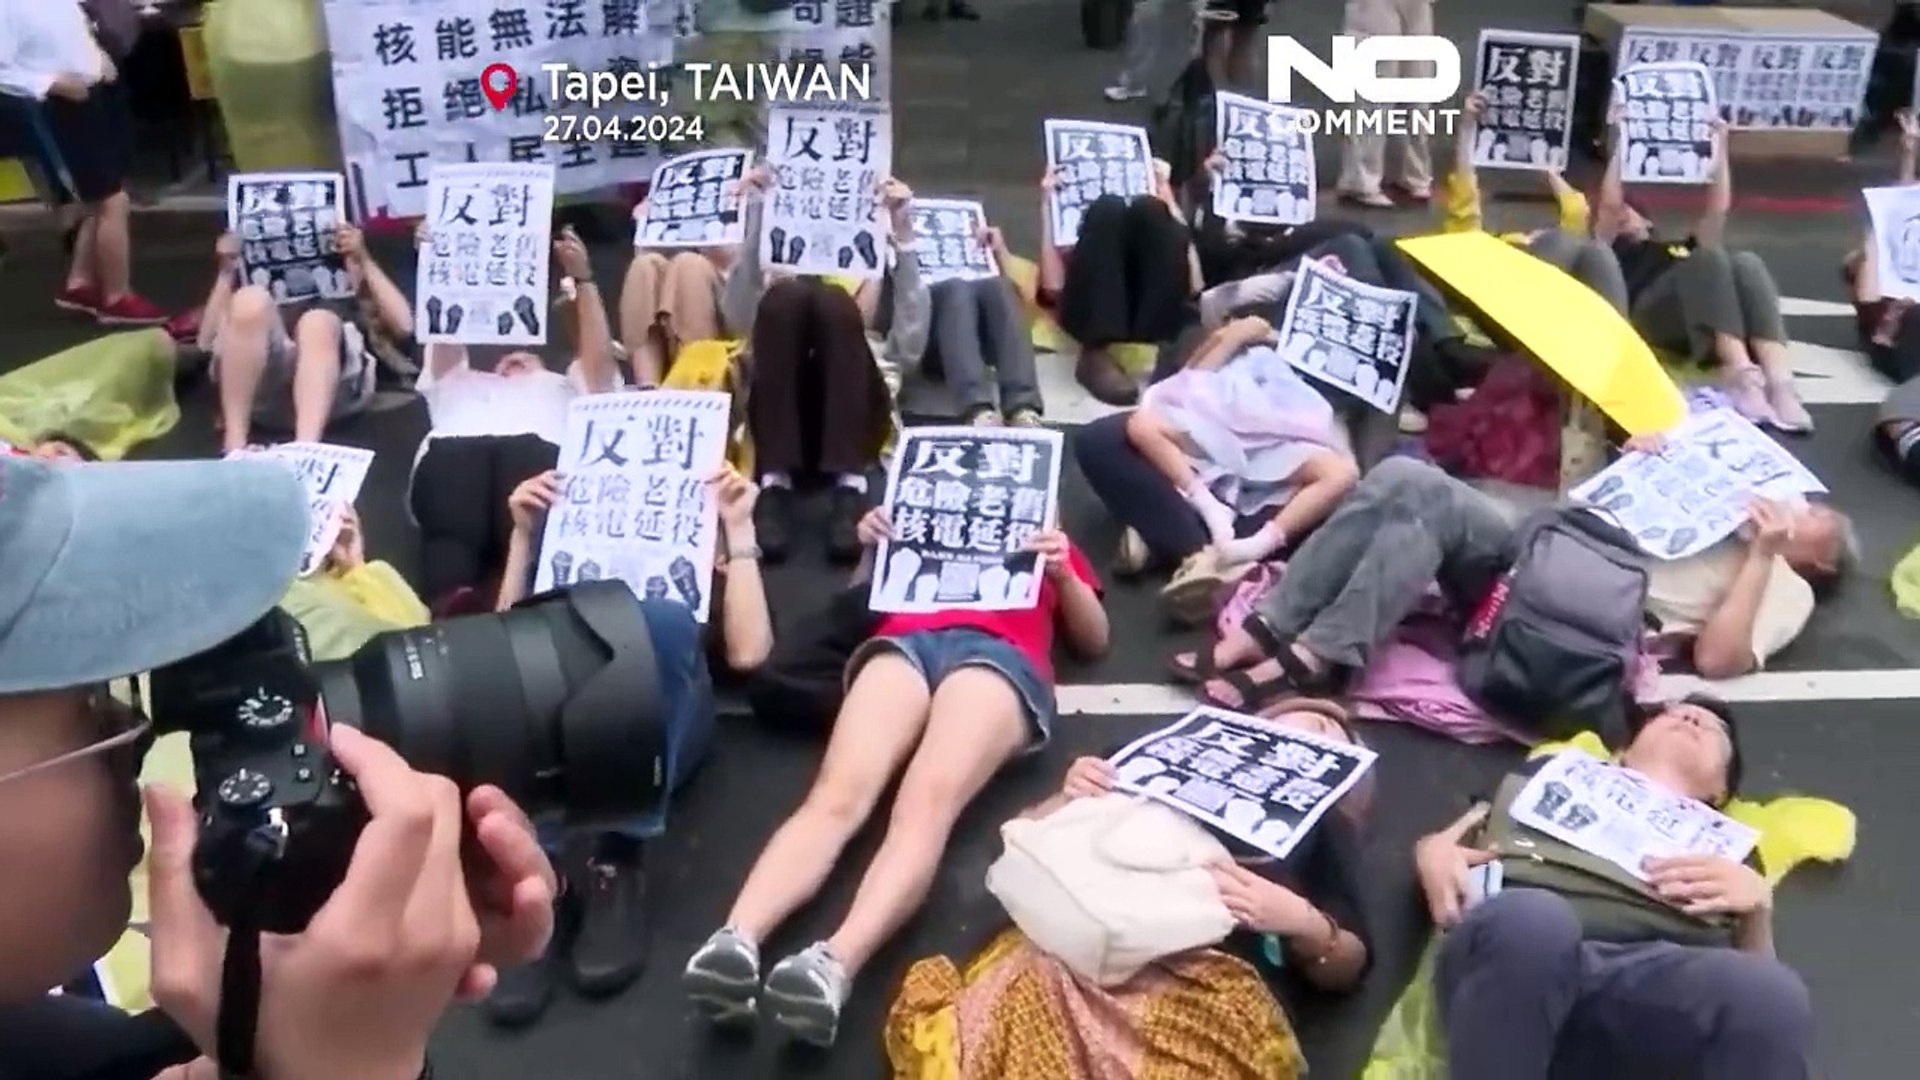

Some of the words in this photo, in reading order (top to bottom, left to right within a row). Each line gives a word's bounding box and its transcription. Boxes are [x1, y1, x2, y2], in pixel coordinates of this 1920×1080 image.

[373, 0, 690, 66] 核能無法解
[1486, 46, 1566, 86] 反對
[783, 116, 877, 164] 反對
[438, 182, 535, 228] 反對
[579, 413, 705, 470] 反對
[906, 439, 1043, 484] 反對
[1189, 720, 1342, 779] 反對
